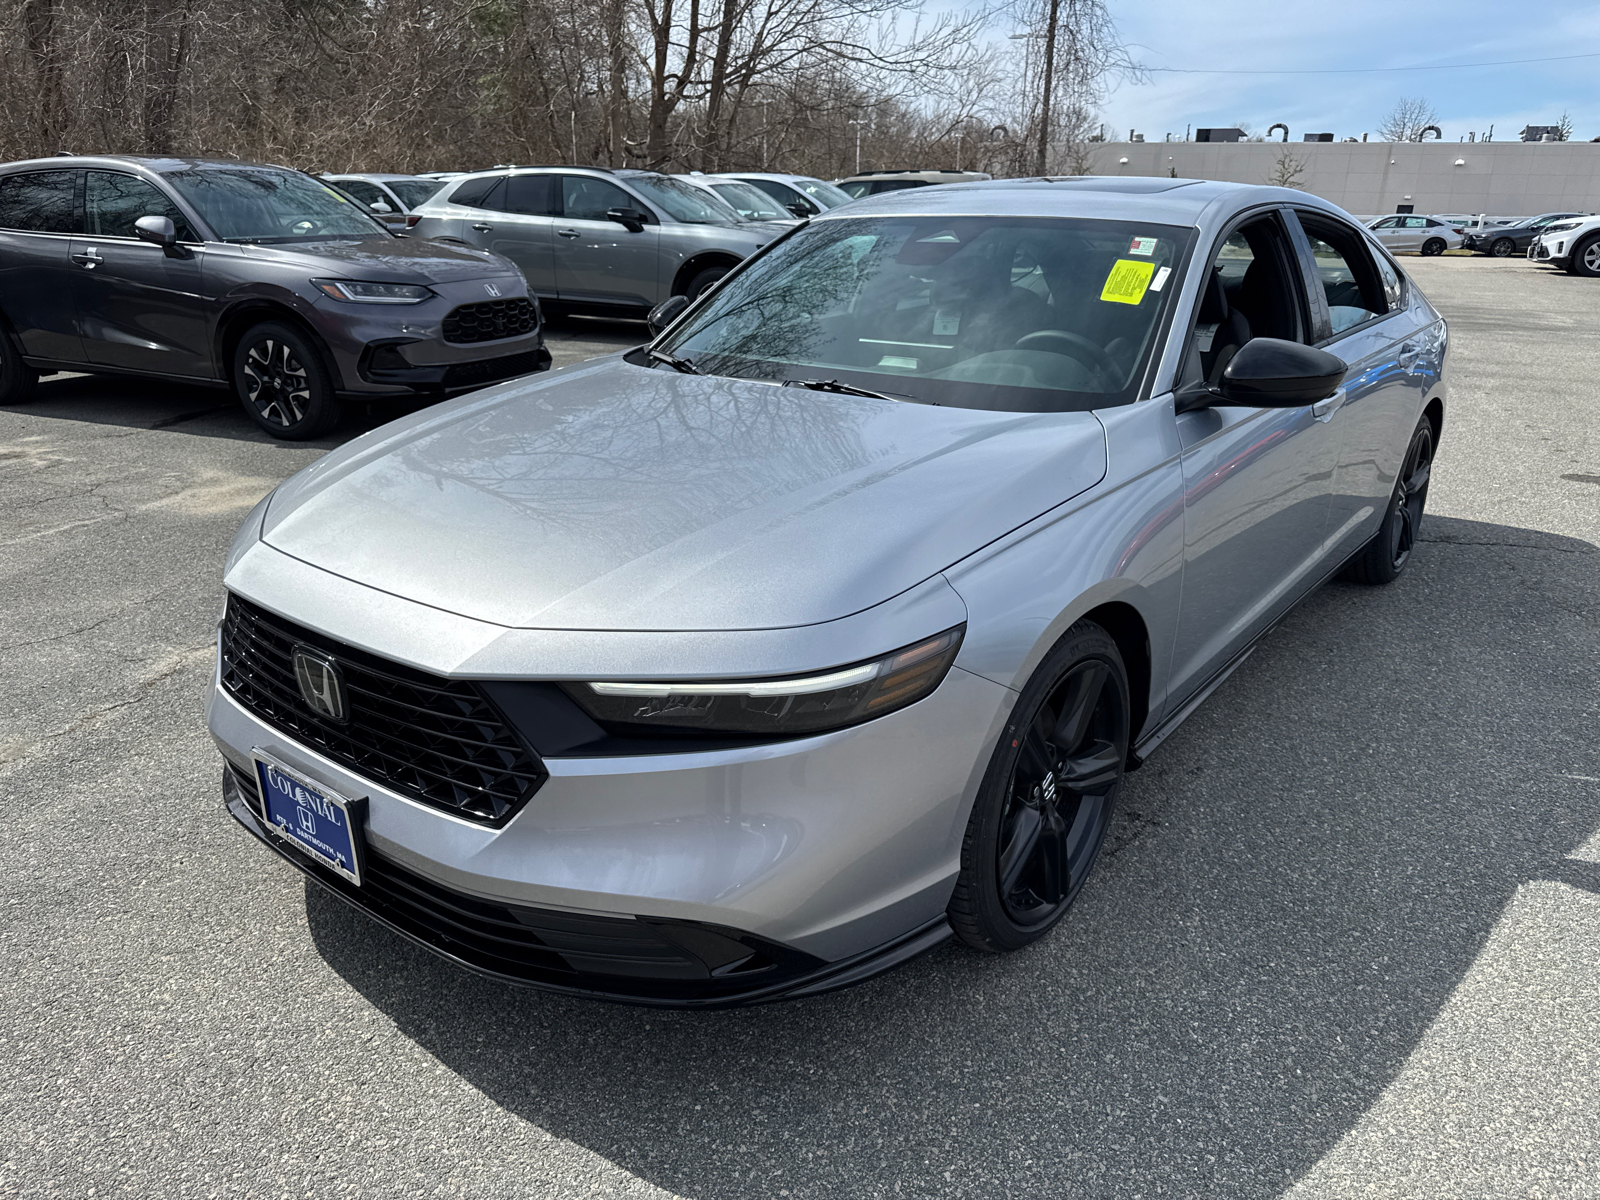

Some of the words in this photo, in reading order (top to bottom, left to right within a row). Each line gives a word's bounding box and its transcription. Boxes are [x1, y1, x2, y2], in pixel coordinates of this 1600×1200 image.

[268, 768, 340, 826] COLONIAL
[286, 834, 314, 856] COLONIAL
[337, 851, 346, 863] MA
